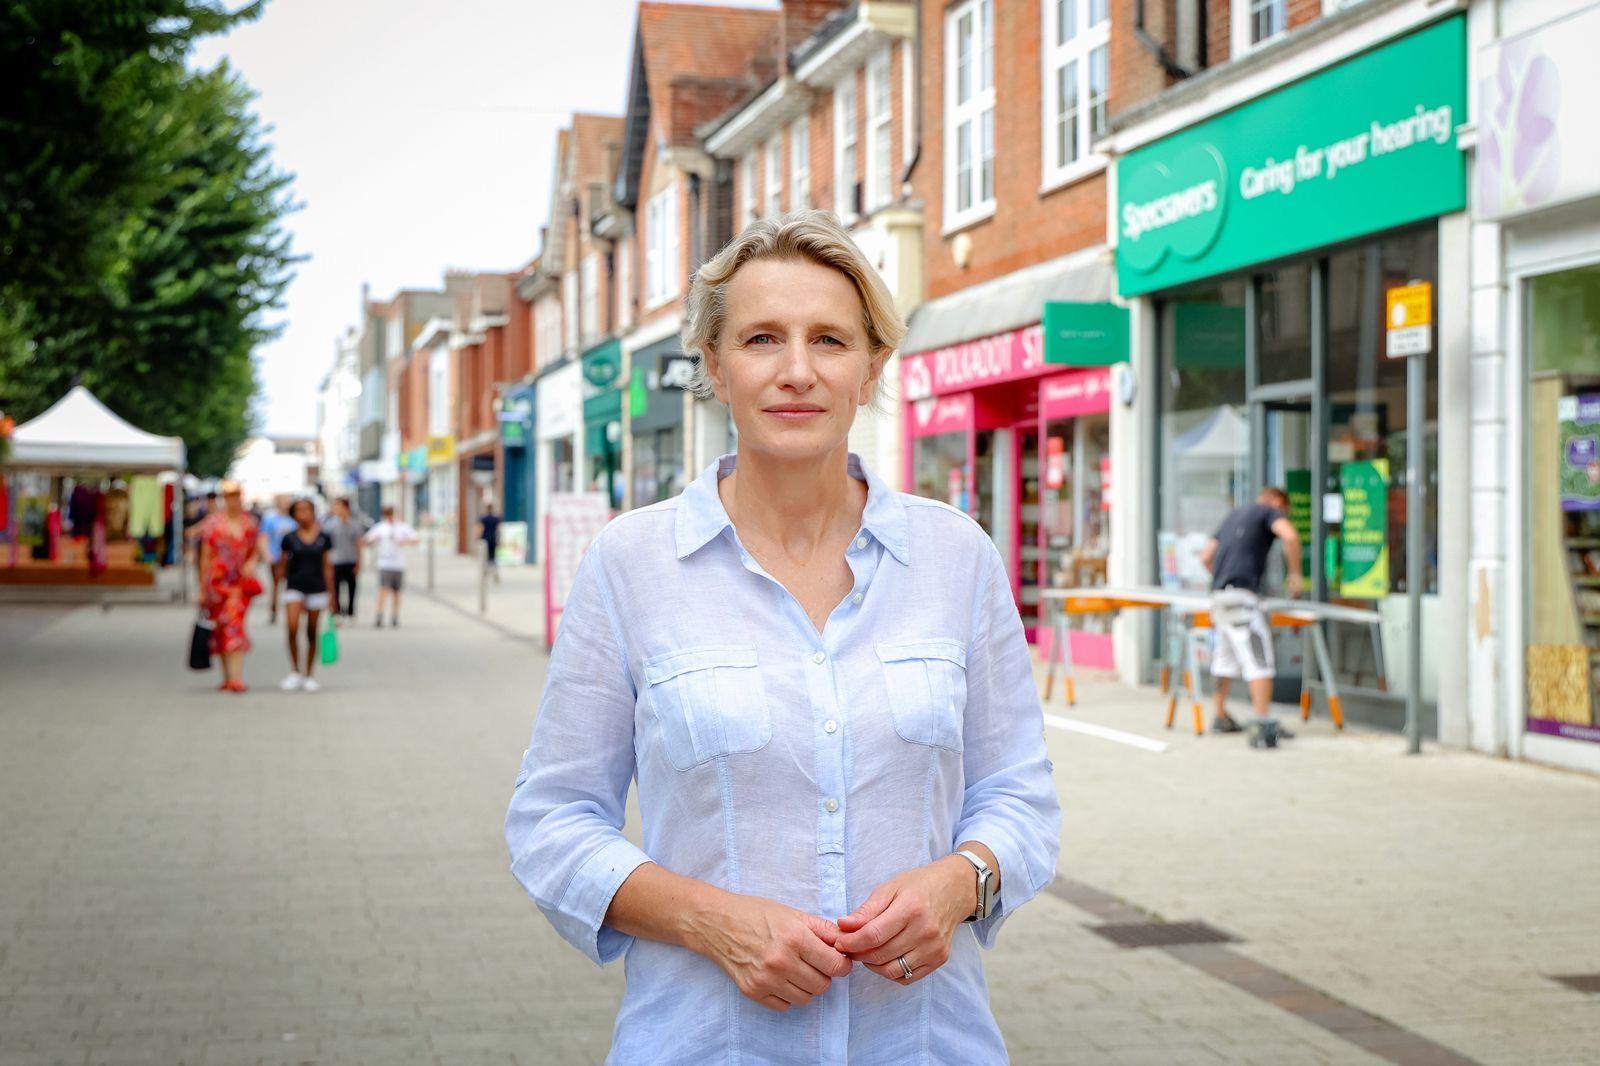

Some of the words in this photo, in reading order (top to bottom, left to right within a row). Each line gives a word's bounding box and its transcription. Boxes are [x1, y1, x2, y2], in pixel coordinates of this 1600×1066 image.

[1240, 158, 1295, 199] Caring
[1296, 145, 1323, 182] for
[1325, 133, 1369, 179] your
[1371, 105, 1451, 156] hearing
[1123, 180, 1217, 241] Specsavers
[934, 335, 1013, 387] POLKADOT
